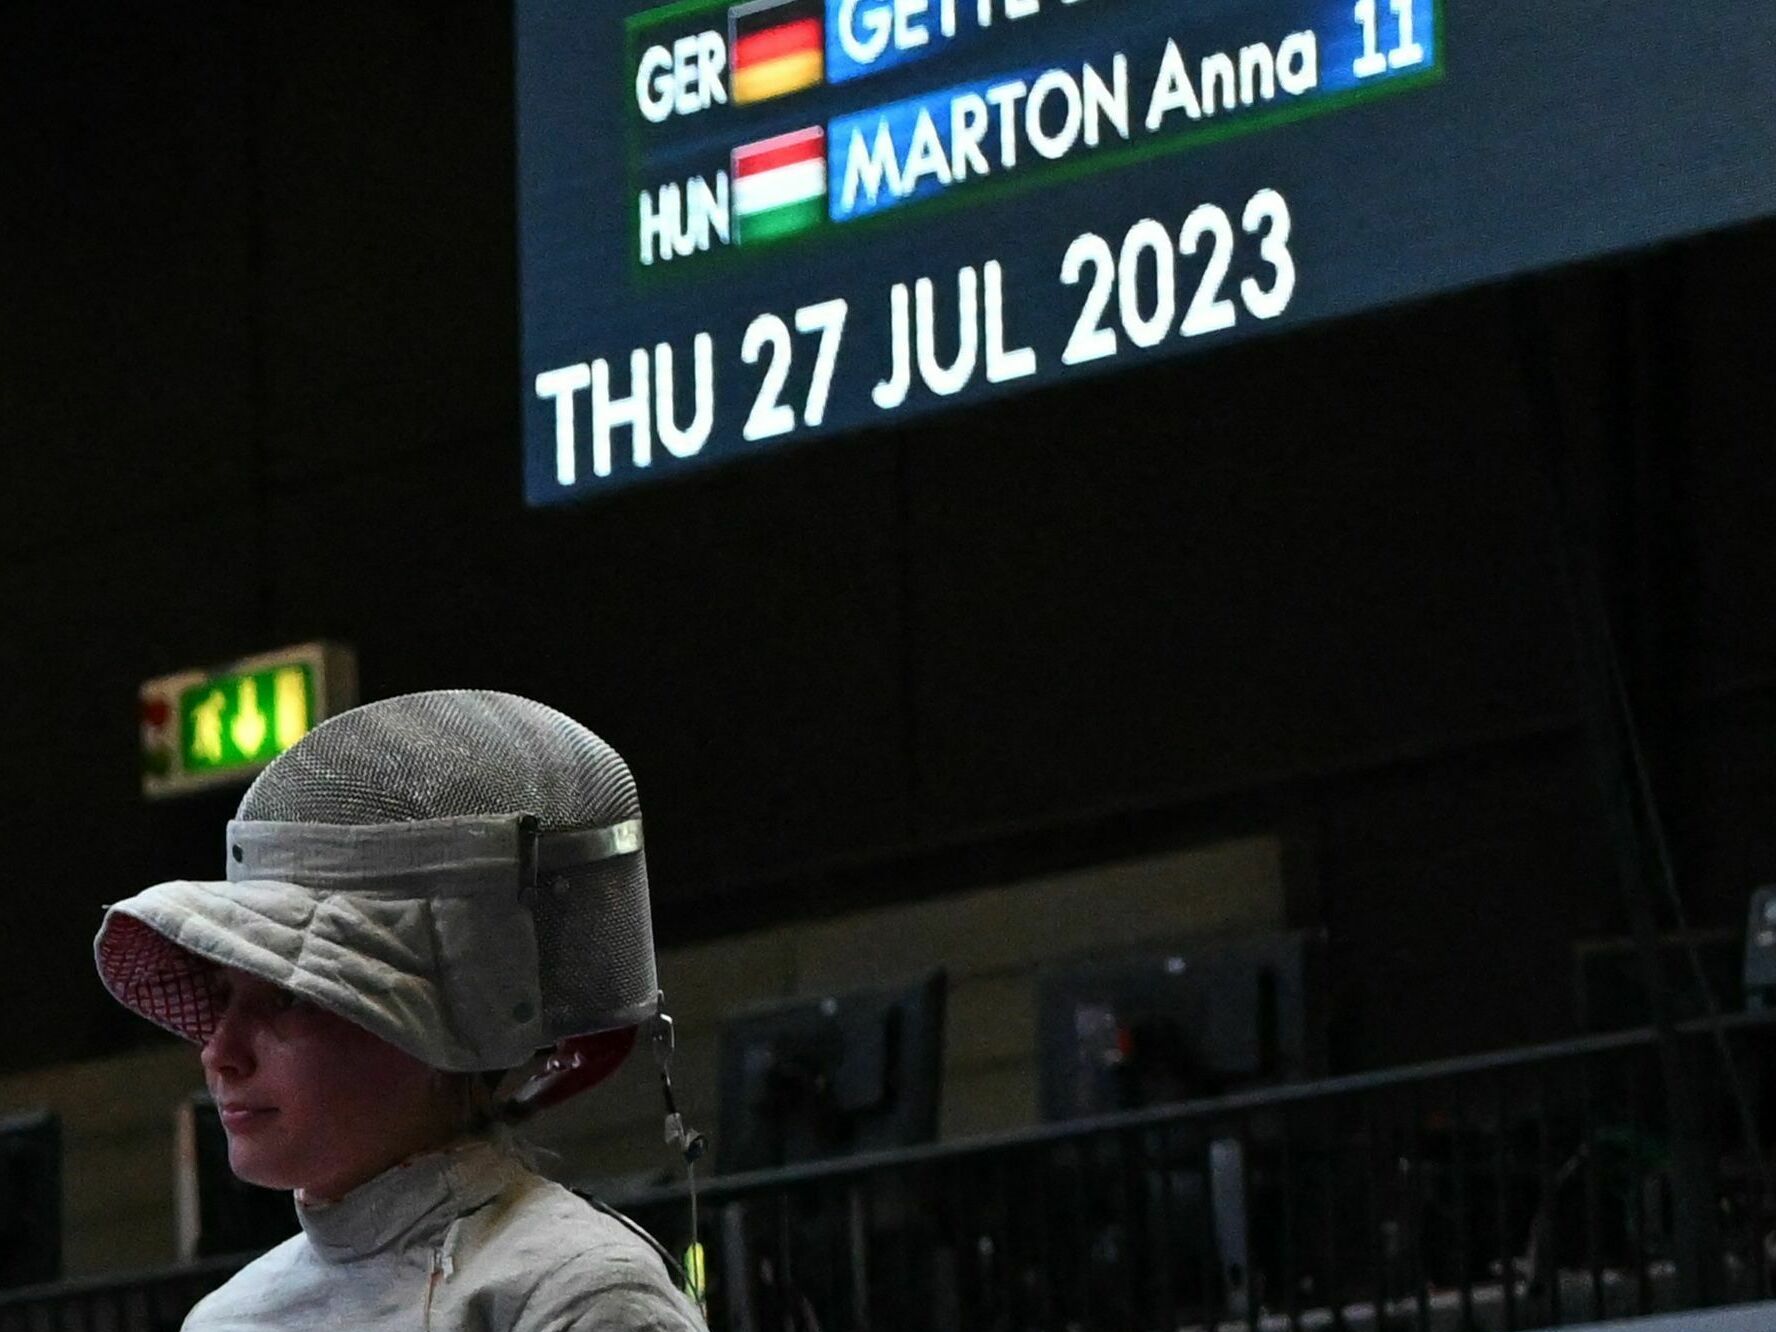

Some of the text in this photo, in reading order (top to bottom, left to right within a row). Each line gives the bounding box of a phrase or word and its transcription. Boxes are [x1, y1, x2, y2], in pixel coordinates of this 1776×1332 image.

[635, 29, 728, 123] GER
[638, 0, 1424, 266] HUN MARTON Anna 11
[536, 188, 1298, 486] THU 27 JUL 2023
